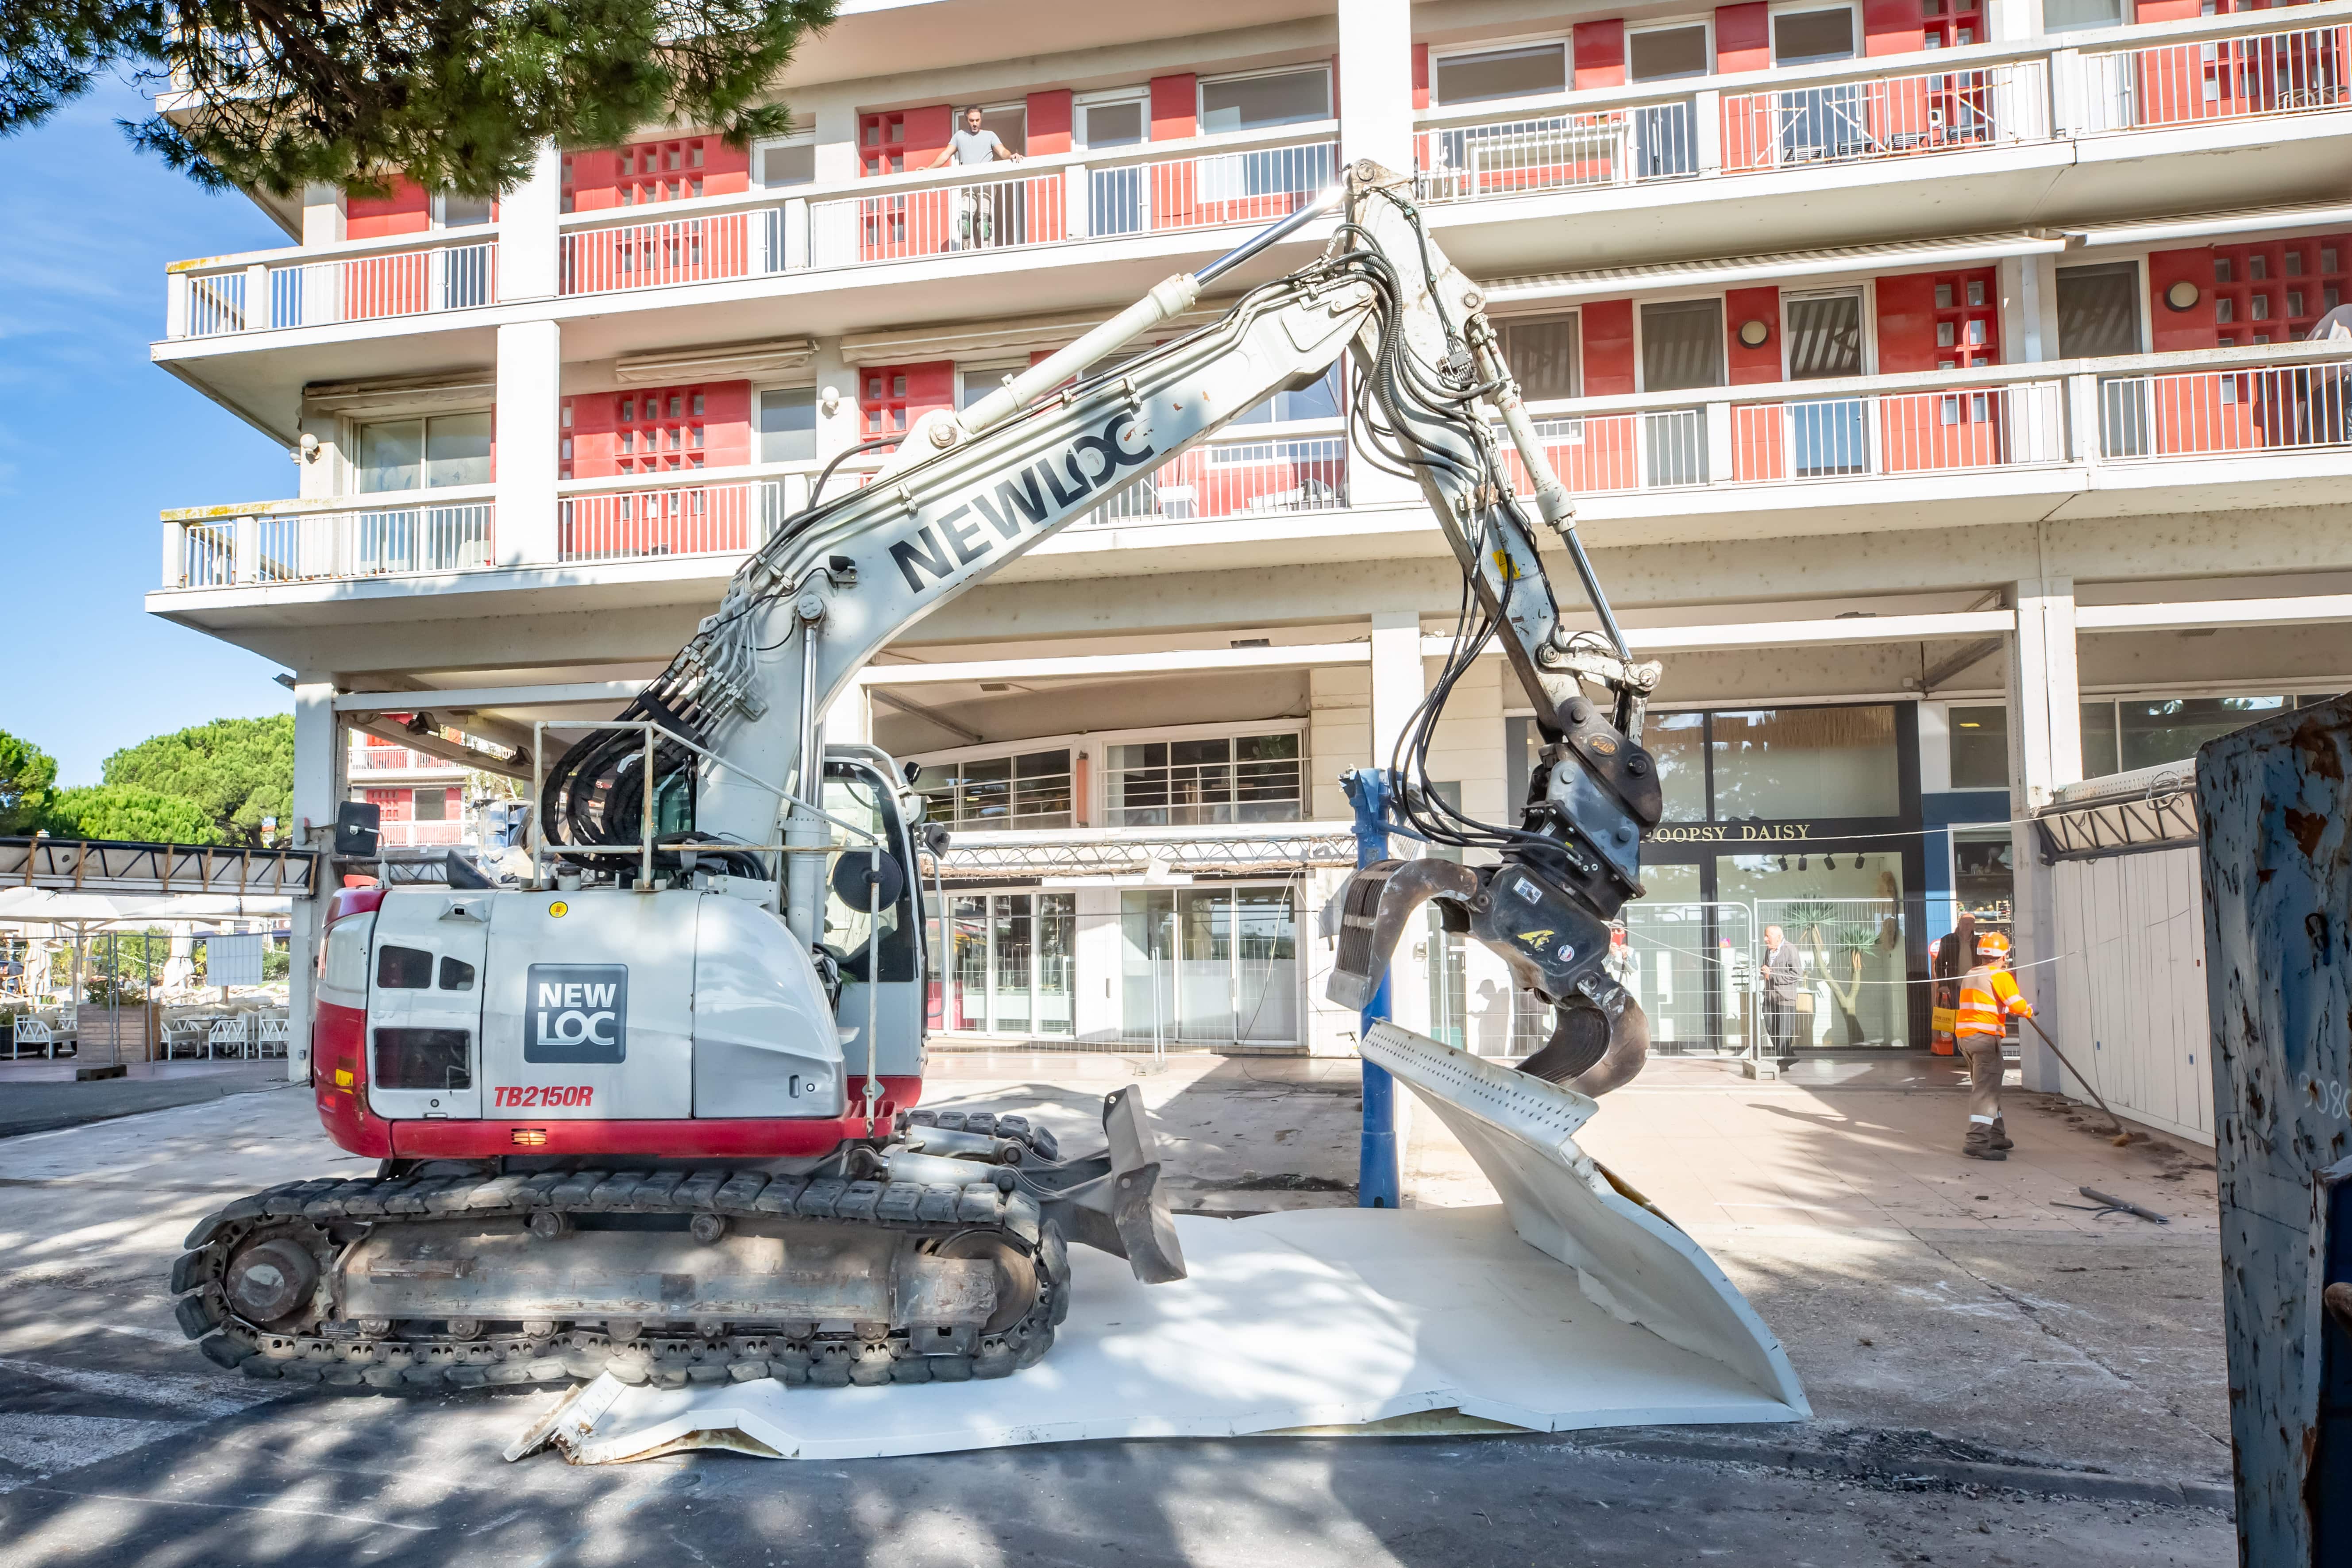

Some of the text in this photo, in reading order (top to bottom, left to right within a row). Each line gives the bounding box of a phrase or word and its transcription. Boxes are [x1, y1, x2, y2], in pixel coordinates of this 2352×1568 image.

[888, 412, 1154, 594] NEWLOC
[1639, 824, 1811, 843] OOPSY DAISY
[538, 982, 617, 1008] NEW
[536, 1010, 616, 1046] LOC
[494, 1086, 594, 1107] TB2150R
